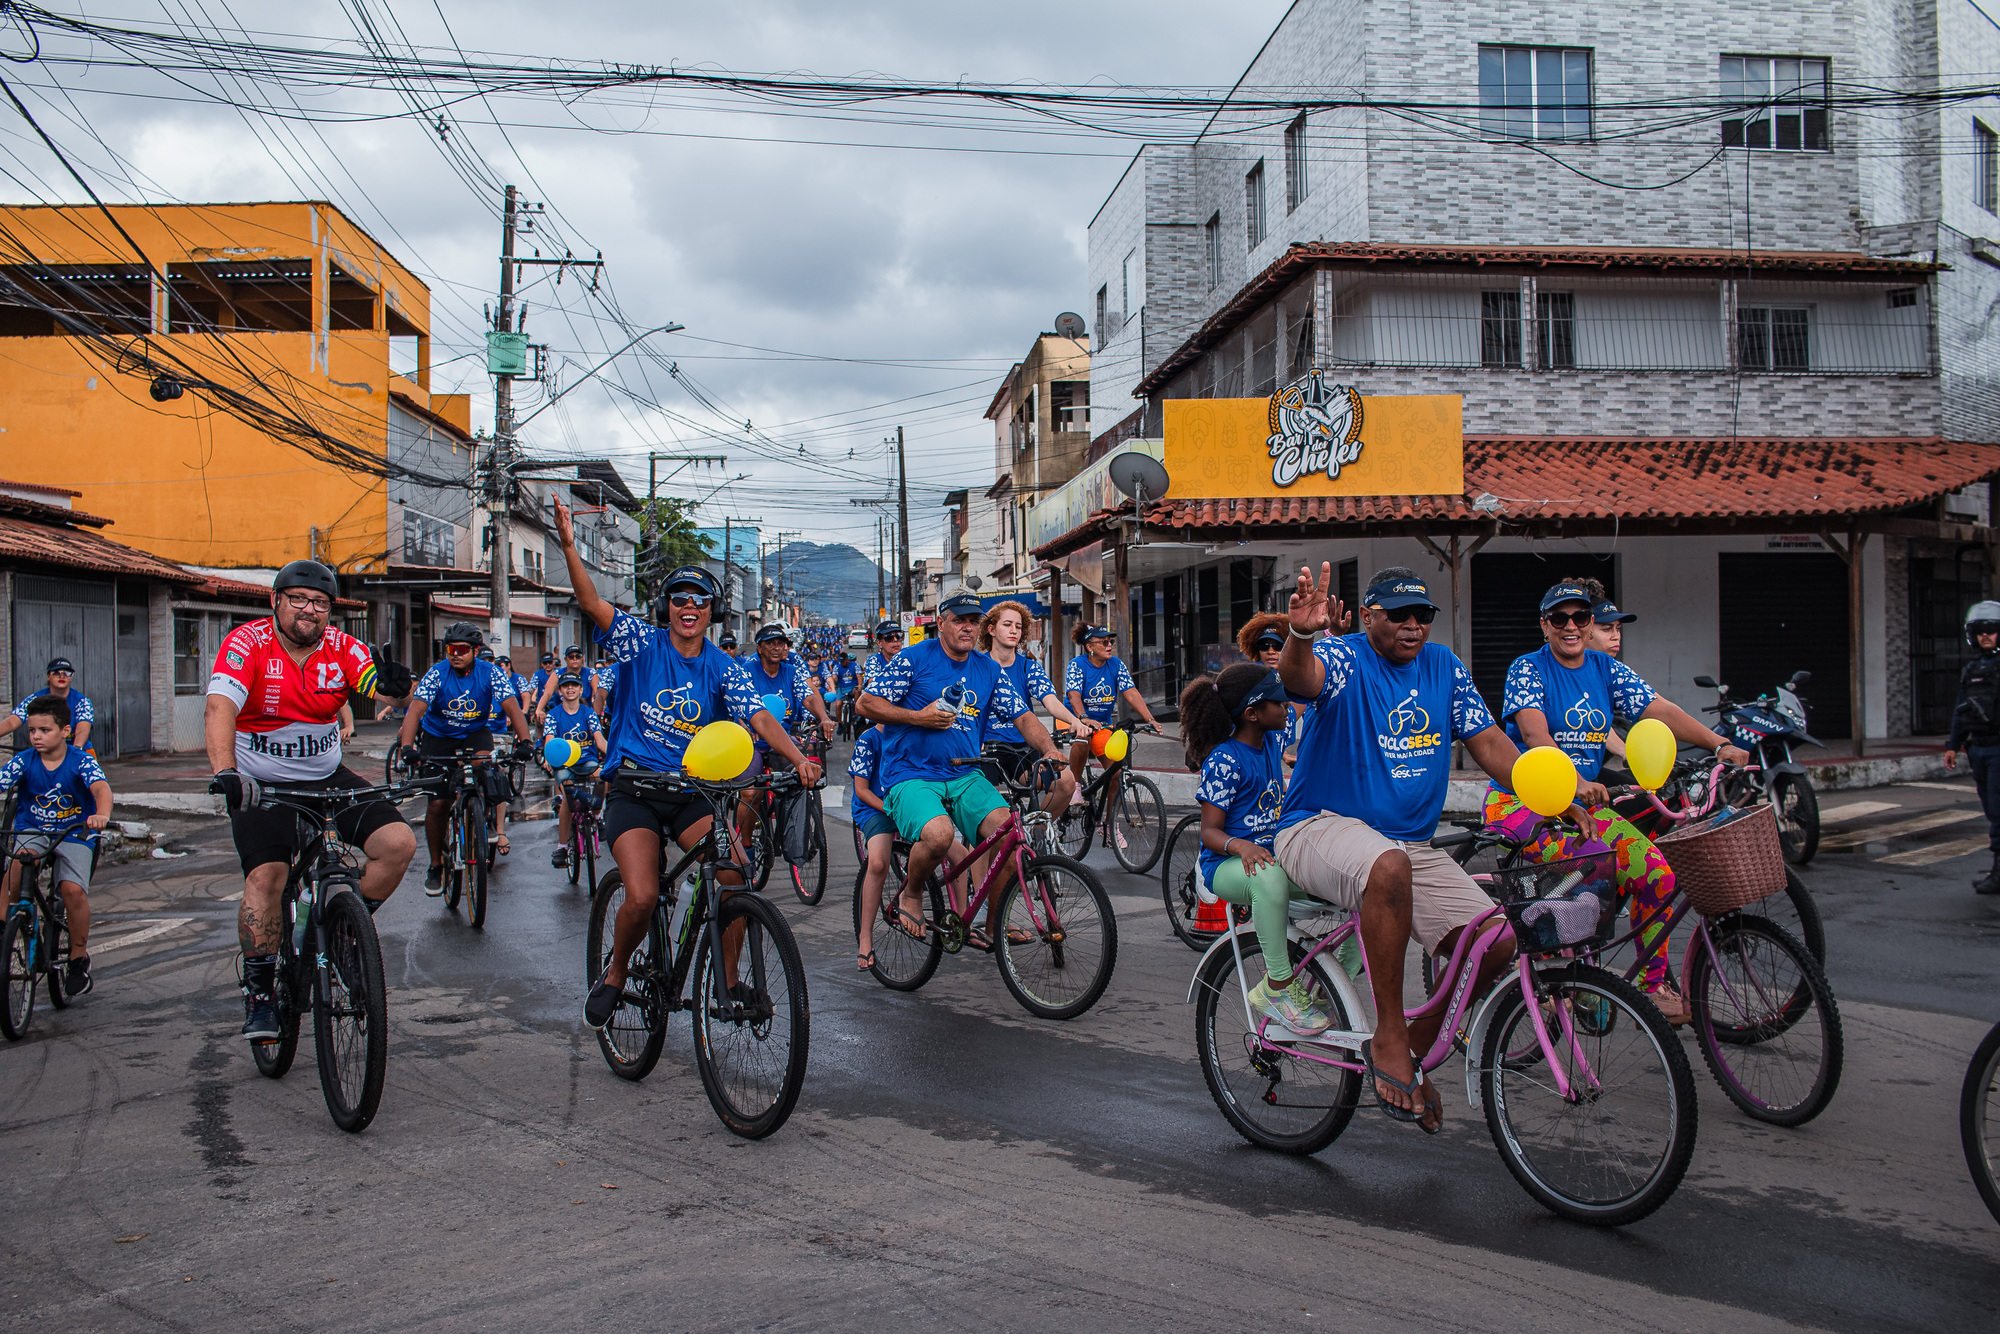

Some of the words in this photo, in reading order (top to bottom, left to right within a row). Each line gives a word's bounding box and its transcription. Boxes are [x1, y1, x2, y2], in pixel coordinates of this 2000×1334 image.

[1267, 432, 1304, 456] Bar
[1311, 438, 1329, 452] dos
[1272, 437, 1363, 486] Chefes
[316, 661, 345, 689] 12
[640, 701, 704, 736] CICLOSESC
[1752, 715, 1784, 732] GMVV
[248, 727, 339, 758] Marlboro
[1378, 732, 1442, 752] CICLOSESC
[1413, 748, 1435, 757] CIDADE
[1391, 768, 1412, 779] Sesc
